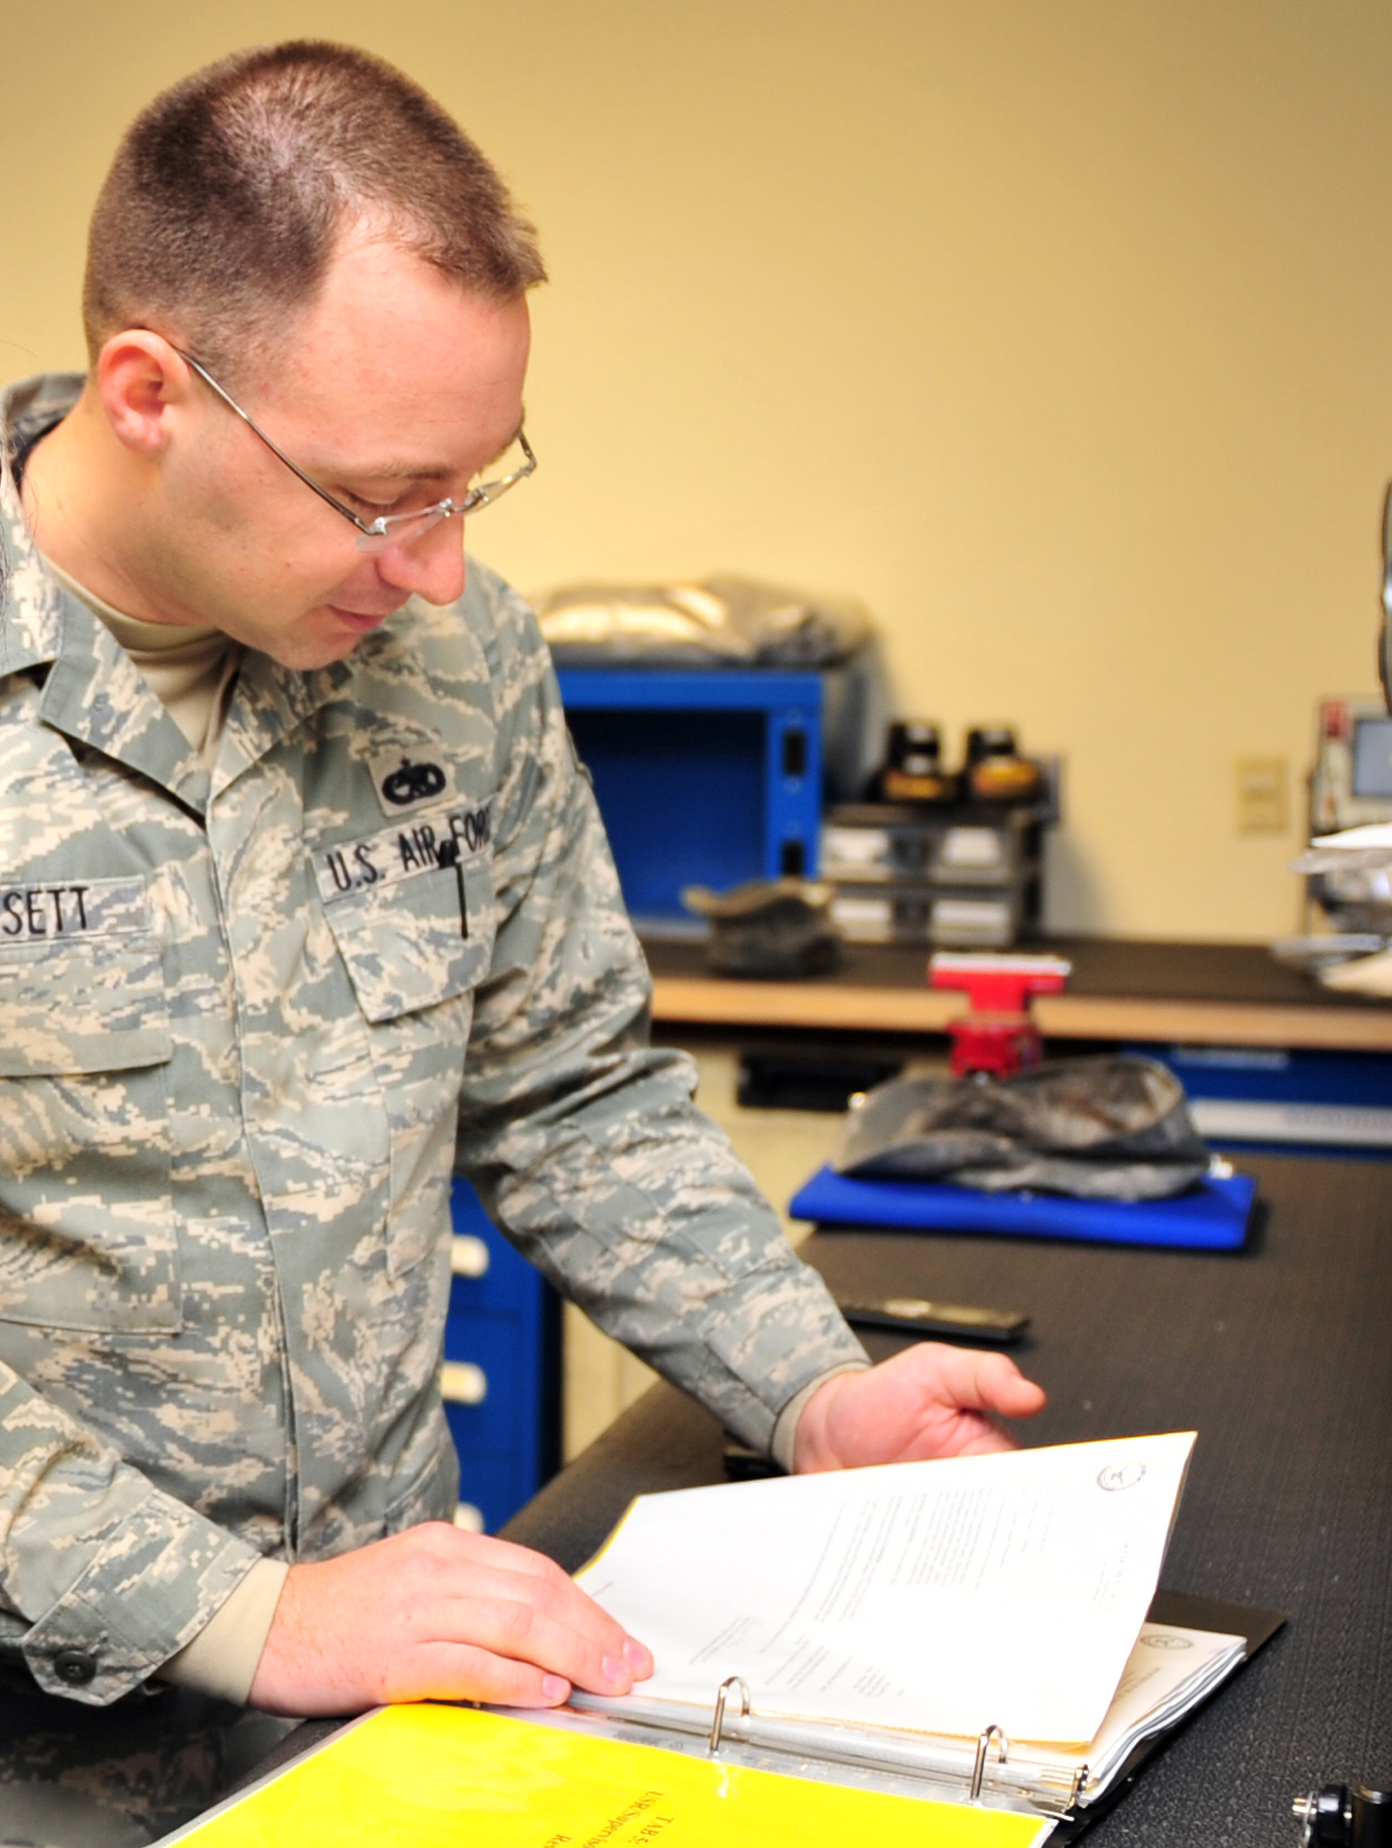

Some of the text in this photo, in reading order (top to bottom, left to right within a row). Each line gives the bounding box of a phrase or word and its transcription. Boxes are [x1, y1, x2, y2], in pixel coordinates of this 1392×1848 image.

[326, 804, 492, 892] U.S. AIR FOR
[640, 1815, 675, 1837] TAB
